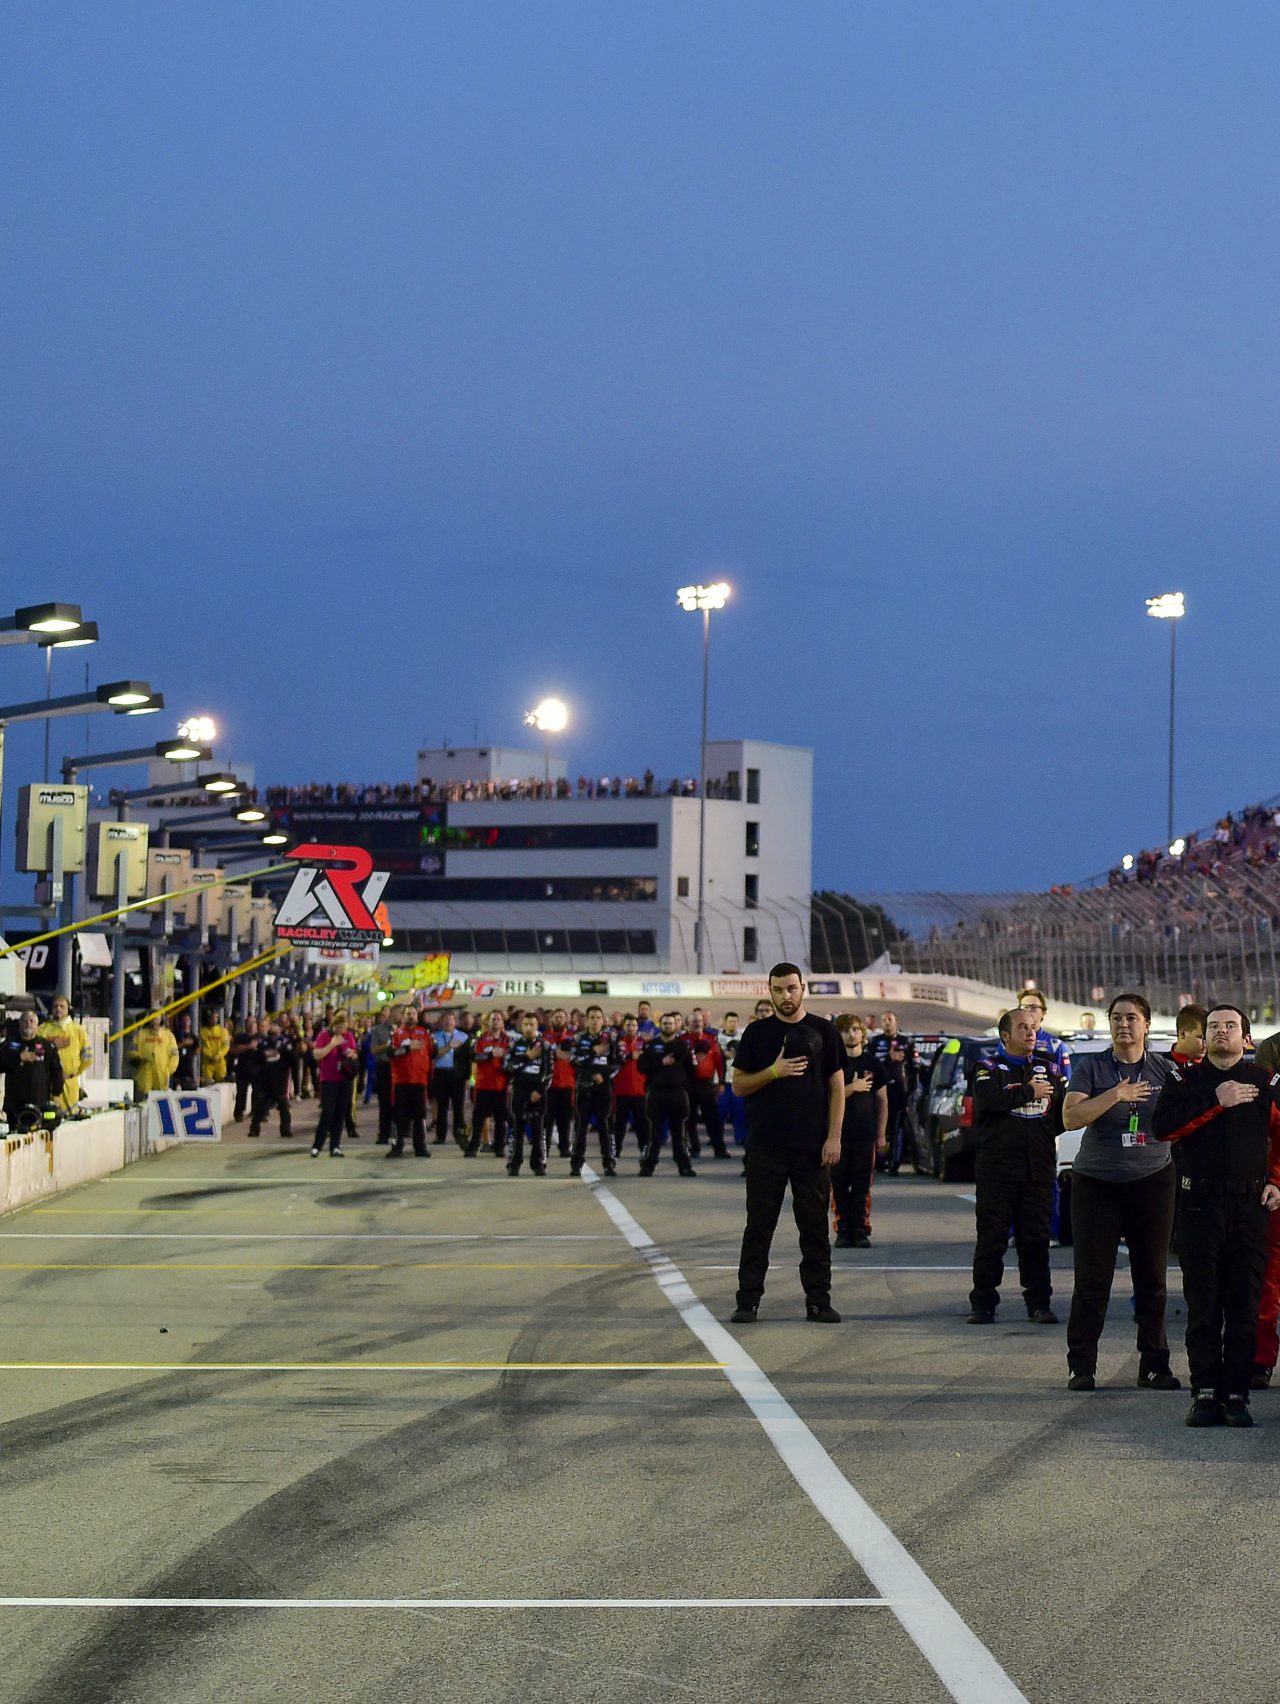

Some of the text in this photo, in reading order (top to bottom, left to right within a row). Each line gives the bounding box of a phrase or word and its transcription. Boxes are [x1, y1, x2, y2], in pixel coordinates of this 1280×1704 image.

[277, 927, 337, 939] RACKLEY
[293, 939, 365, 949] www.rackleywar.com
[156, 1095, 217, 1137] 12
